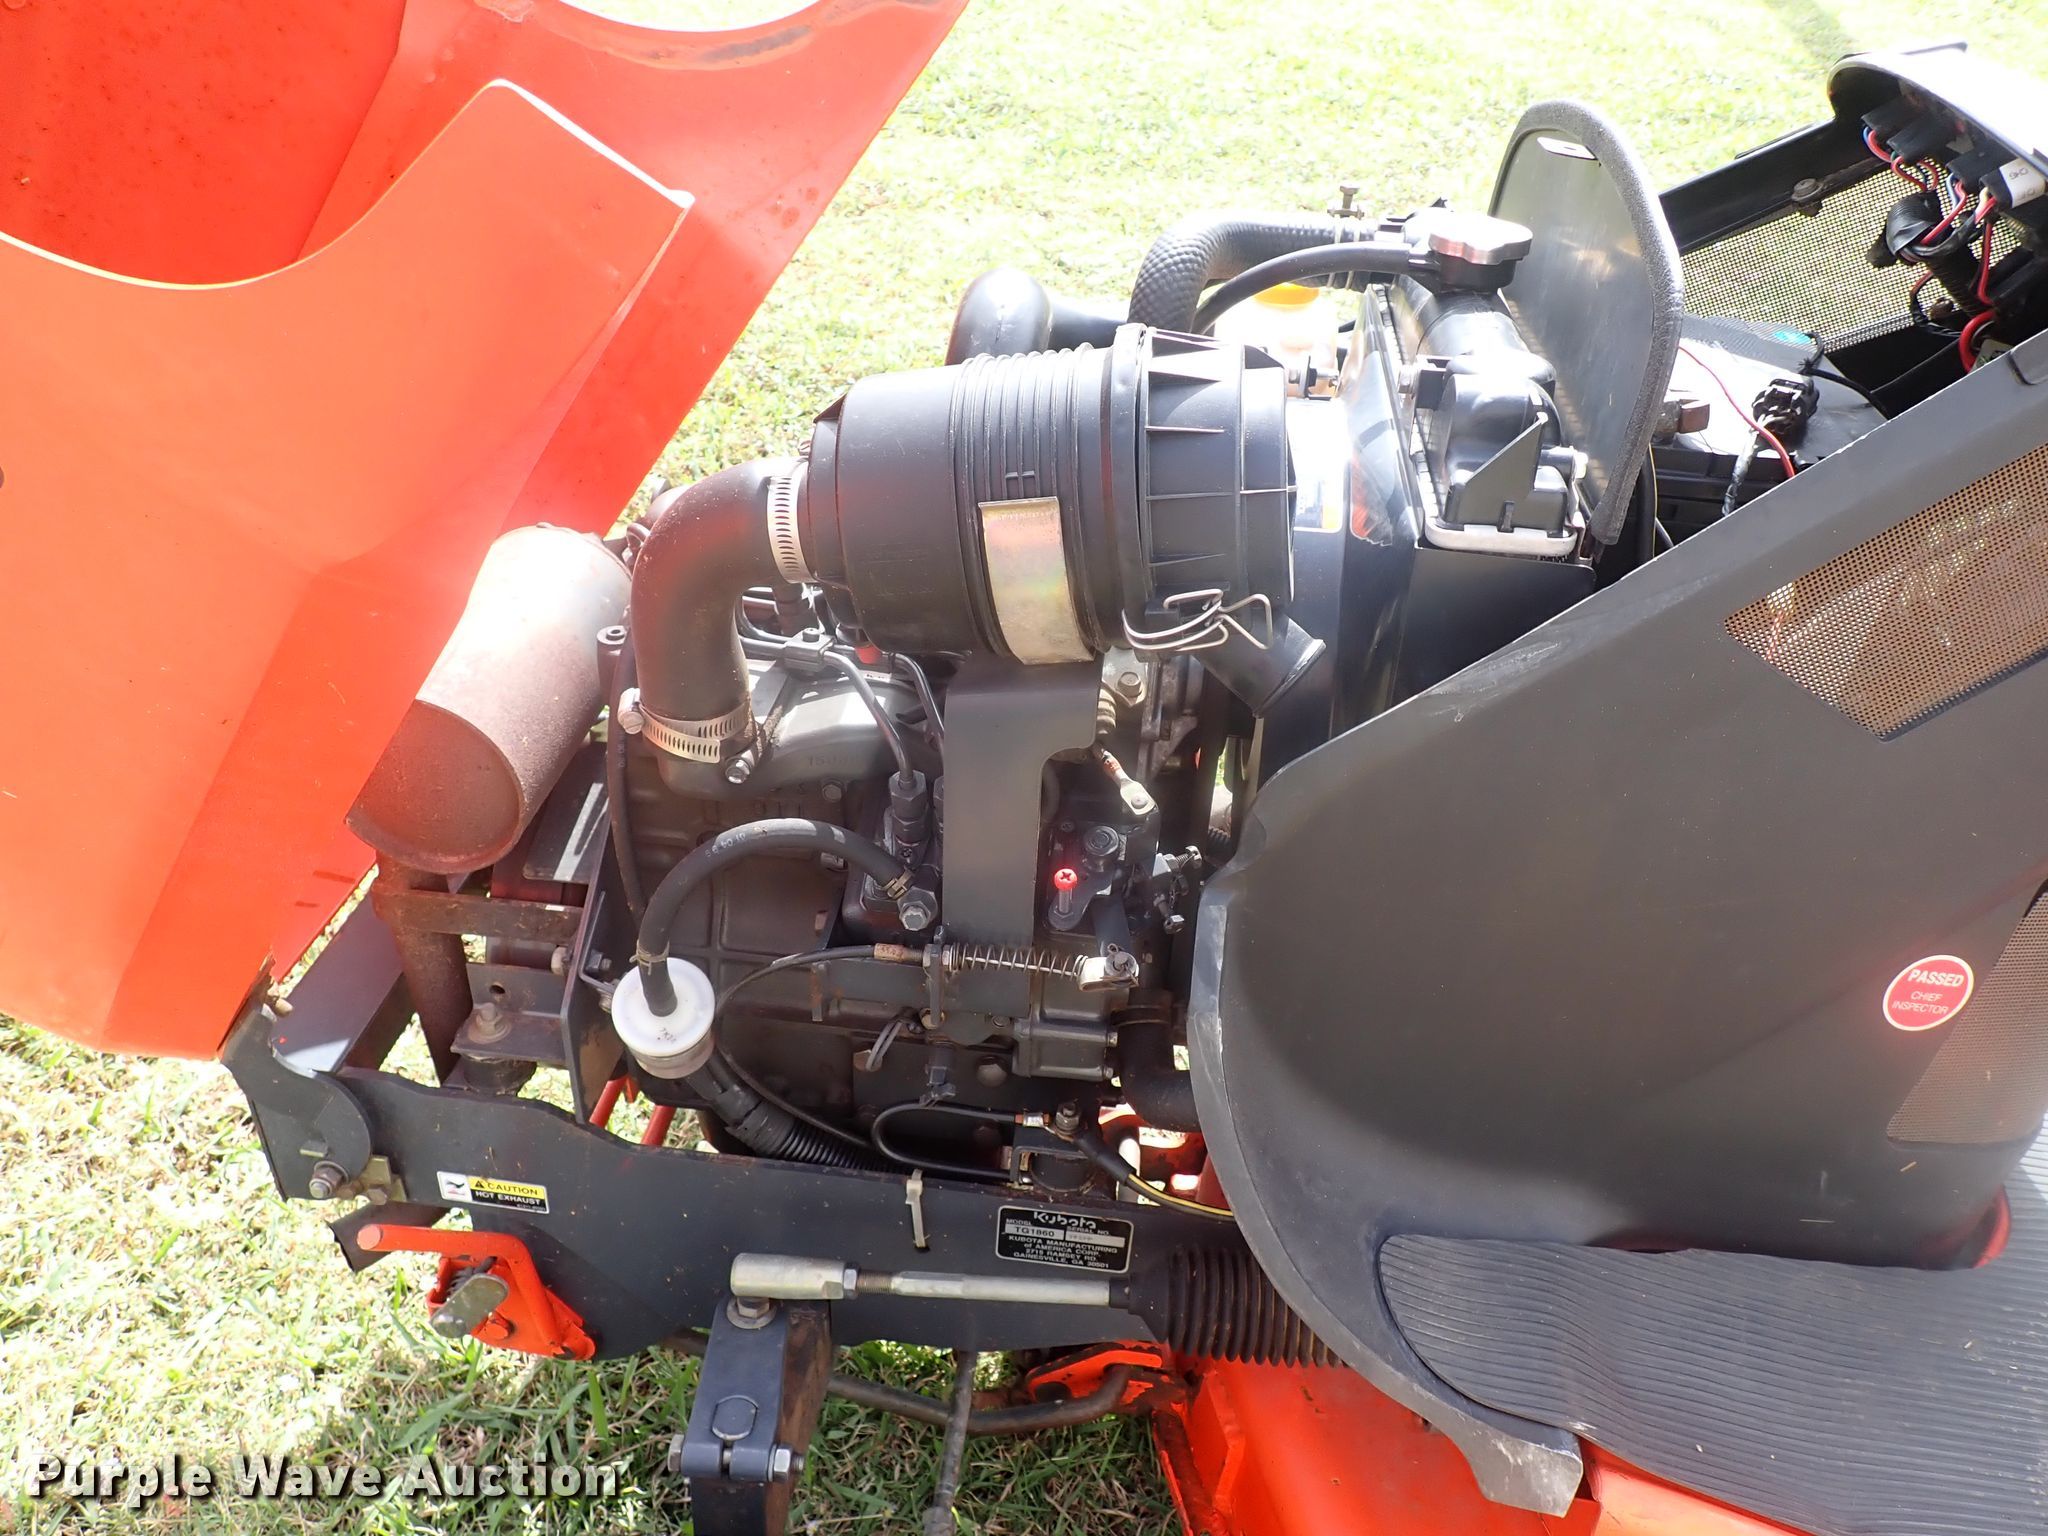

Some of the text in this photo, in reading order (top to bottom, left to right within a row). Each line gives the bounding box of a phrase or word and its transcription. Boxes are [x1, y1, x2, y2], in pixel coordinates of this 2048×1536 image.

[1907, 968, 1964, 987] PASSED
[1910, 991, 1943, 1002] CHIEF
[1892, 1001, 1949, 1015] INSPECTOR
[487, 1182, 538, 1196] CAUTION
[475, 1191, 541, 1206] HOT EXHAUST
[1006, 1218, 1032, 1226] MODEL
[1033, 1211, 1097, 1229] Kubota
[1014, 1226, 1055, 1237] TG1860
[1066, 1225, 1094, 1234] SERIAL
[1008, 1235, 1118, 1254] KUBOTA MANUFACTURING
[1035, 1244, 1072, 1253] AMERICA
